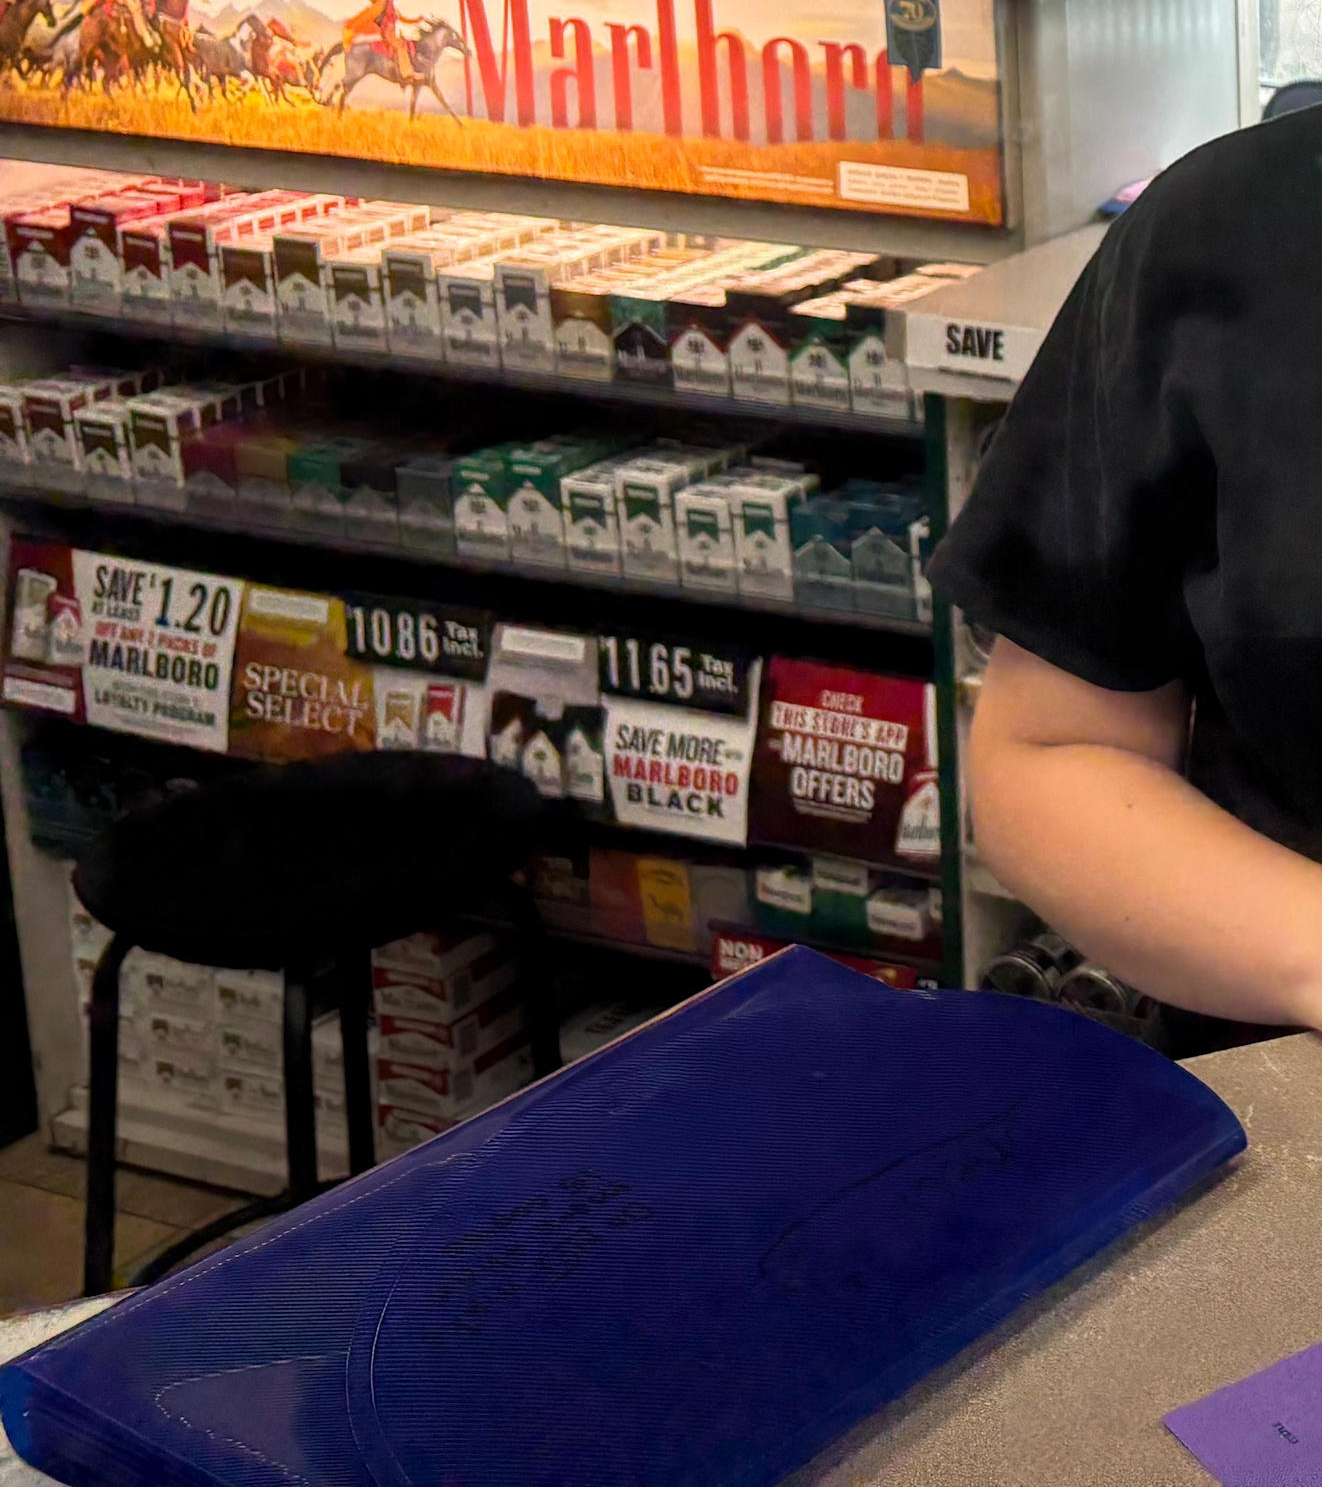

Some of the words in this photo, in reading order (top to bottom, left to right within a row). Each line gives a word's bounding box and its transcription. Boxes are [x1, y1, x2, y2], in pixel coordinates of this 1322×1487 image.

[947, 324, 1004, 361] SAVE
[94, 565, 142, 605] SAVE
[90, 639, 218, 691] MARLBORO
[244, 663, 368, 709] SPECIAL
[821, 690, 864, 713] CHECK
[247, 694, 363, 735] SELECT
[616, 724, 661, 754] SAVE
[667, 729, 725, 762] MORE
[782, 733, 904, 784] MARLBORO
[613, 755, 739, 796] MARLBORO
[791, 768, 874, 810] OFFERS
[628, 785, 723, 818] BLACK
